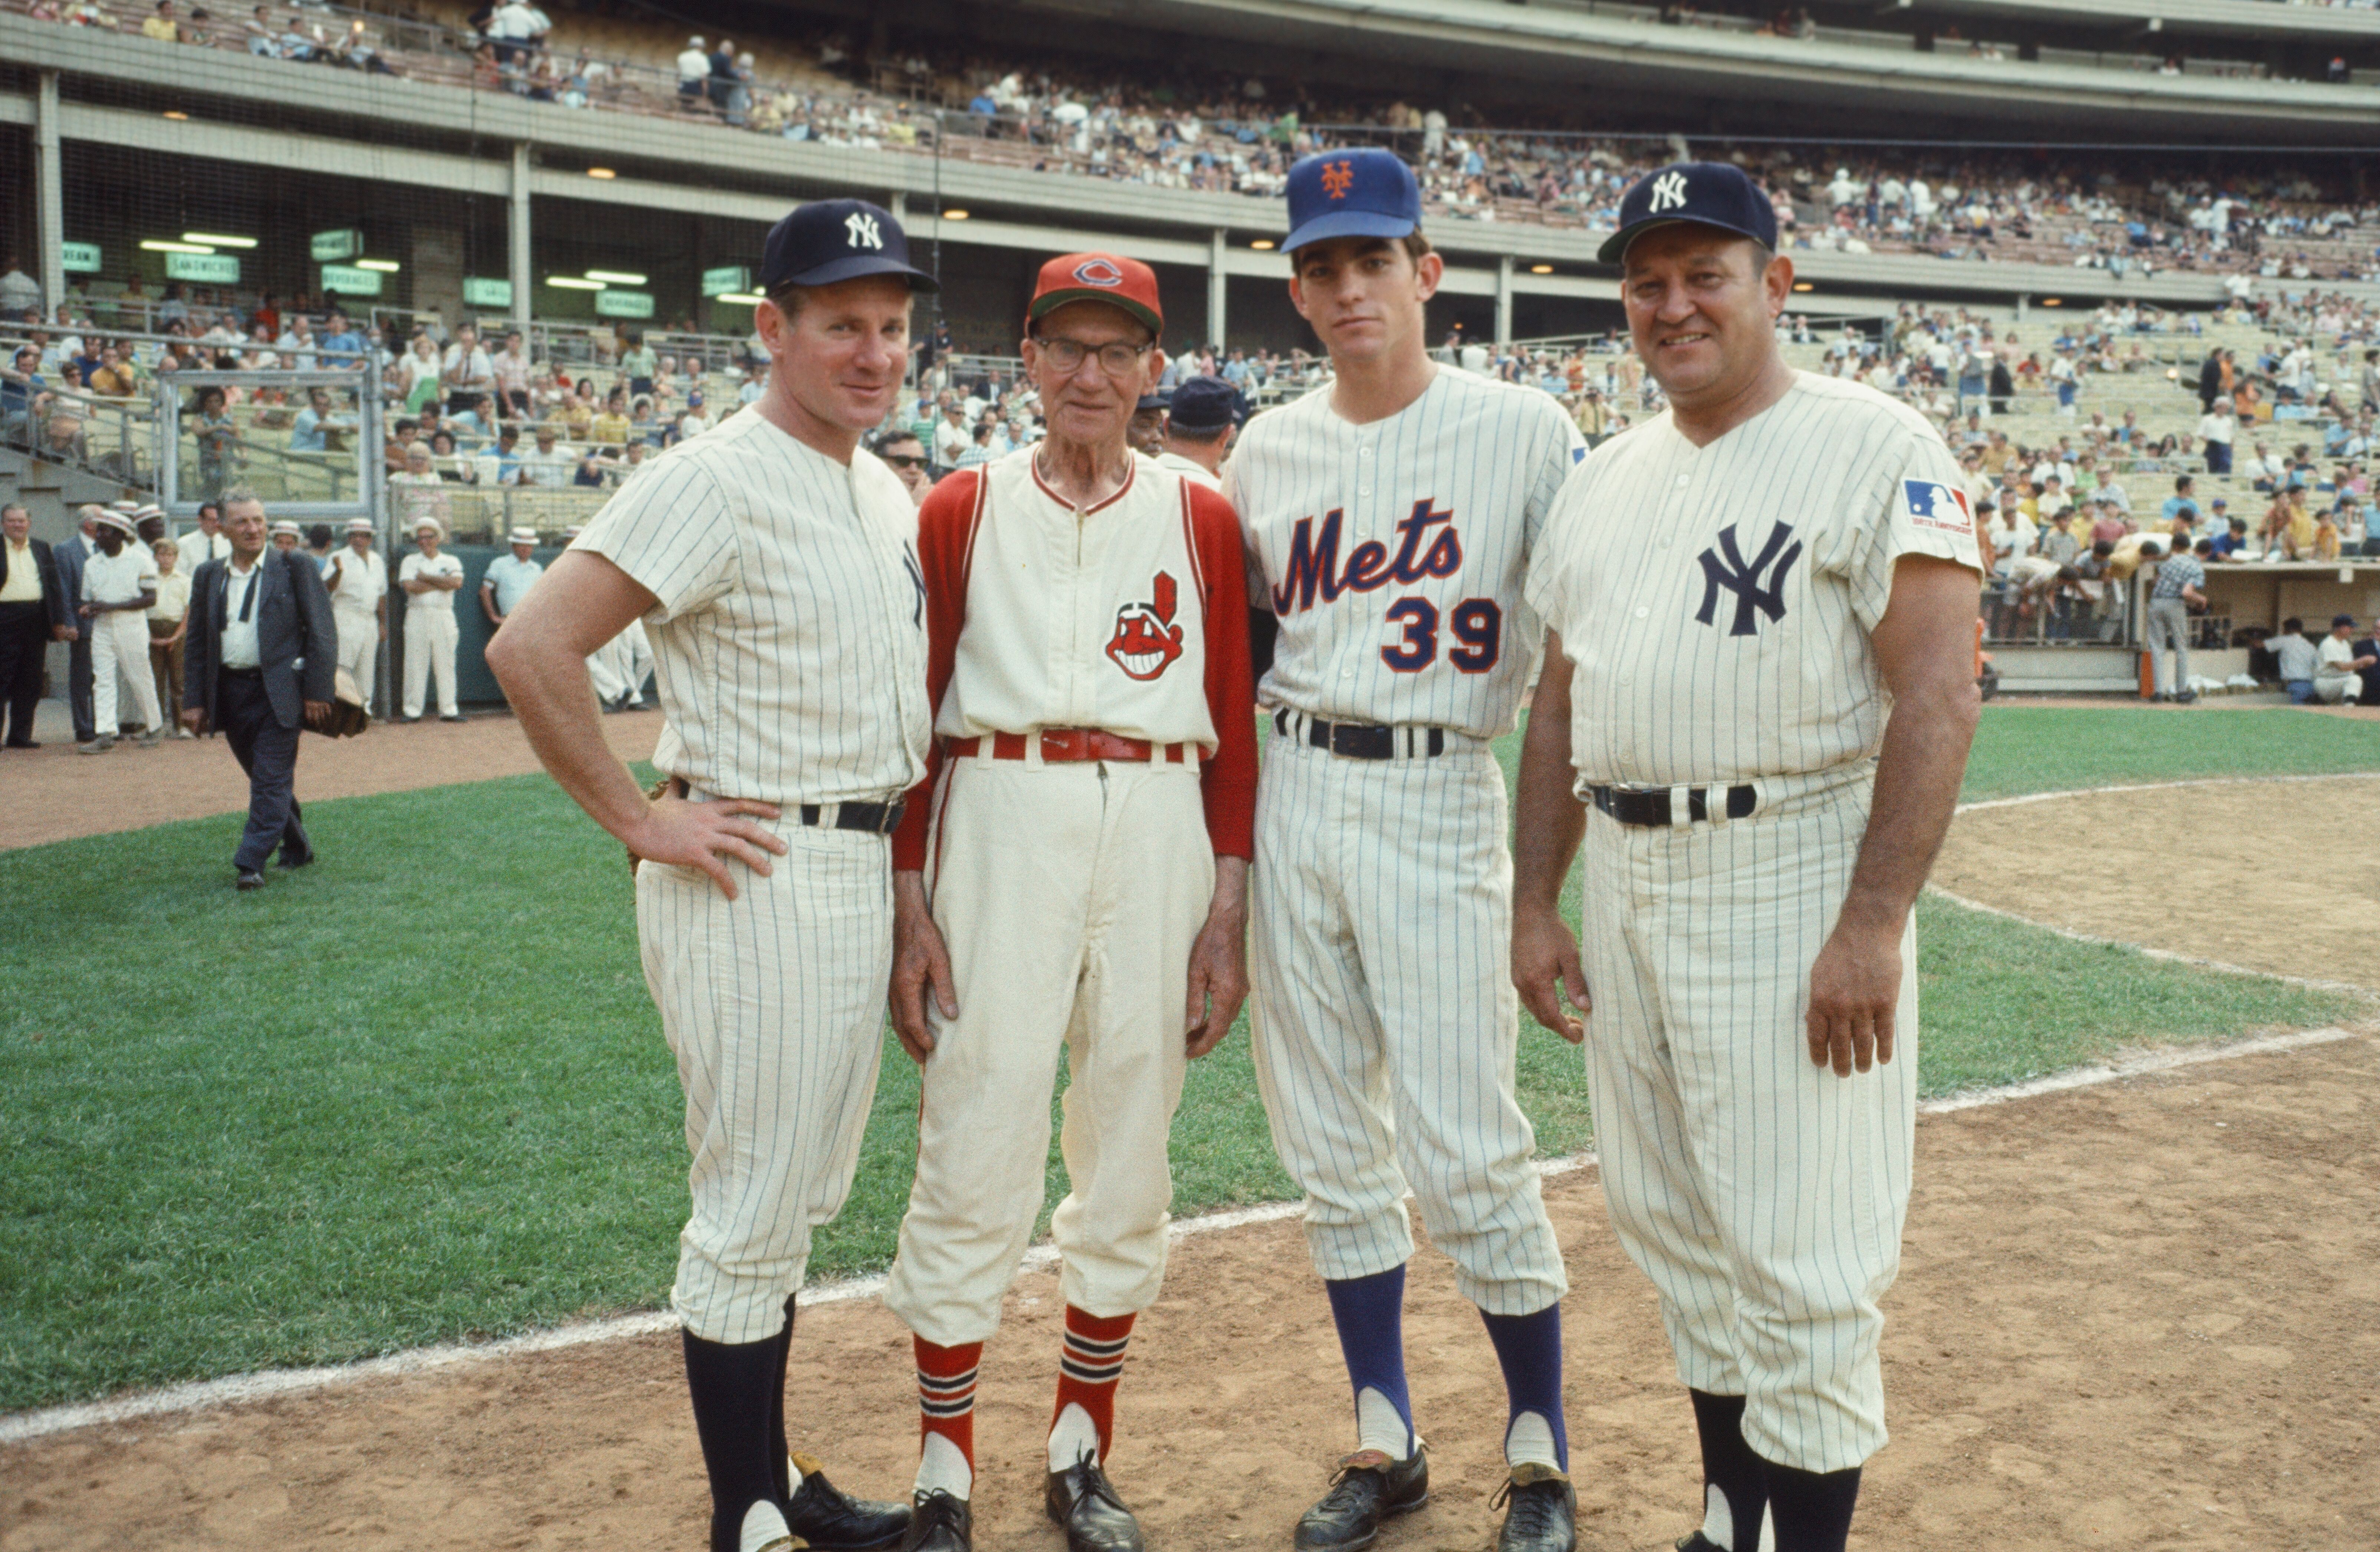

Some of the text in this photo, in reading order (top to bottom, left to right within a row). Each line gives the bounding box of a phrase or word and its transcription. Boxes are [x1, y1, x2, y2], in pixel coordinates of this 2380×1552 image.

[1322, 160, 1353, 200] NY
[1649, 171, 1687, 213] NY
[845, 212, 883, 250] NY
[63, 250, 91, 261] REAM
[1073, 259, 1122, 287] C
[1273, 497, 1463, 616] Mets
[1695, 520, 1803, 636] NY
[1381, 596, 1501, 674] 39
